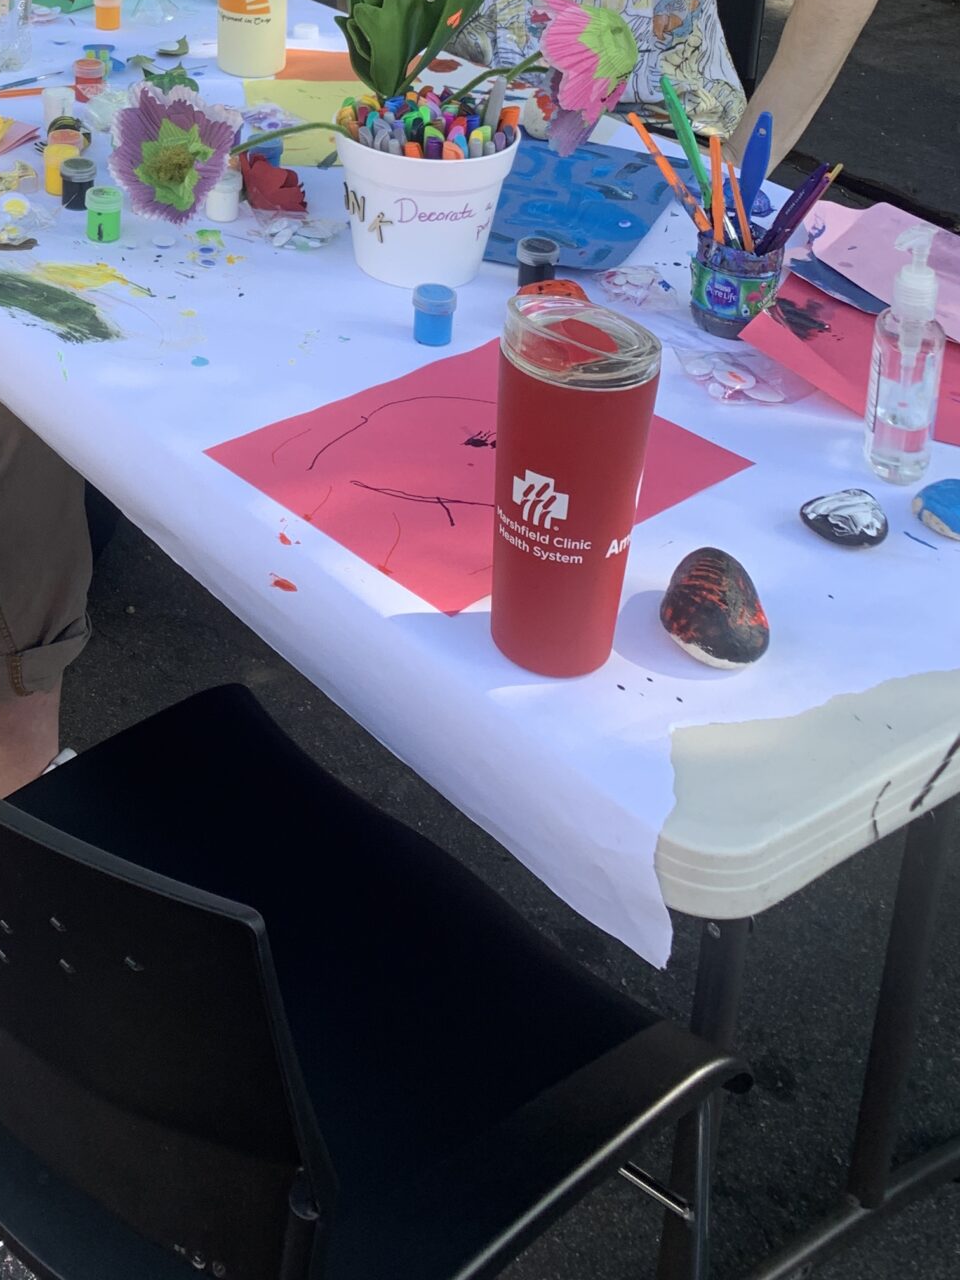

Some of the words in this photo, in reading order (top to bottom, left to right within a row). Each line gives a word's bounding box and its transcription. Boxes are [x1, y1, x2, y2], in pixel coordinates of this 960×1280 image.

[394, 197, 476, 223] Decorate
[497, 505, 549, 545] Marshfield
[553, 535, 592, 550] Clinic
[499, 524, 530, 553] Health
[533, 546, 583, 564] System
